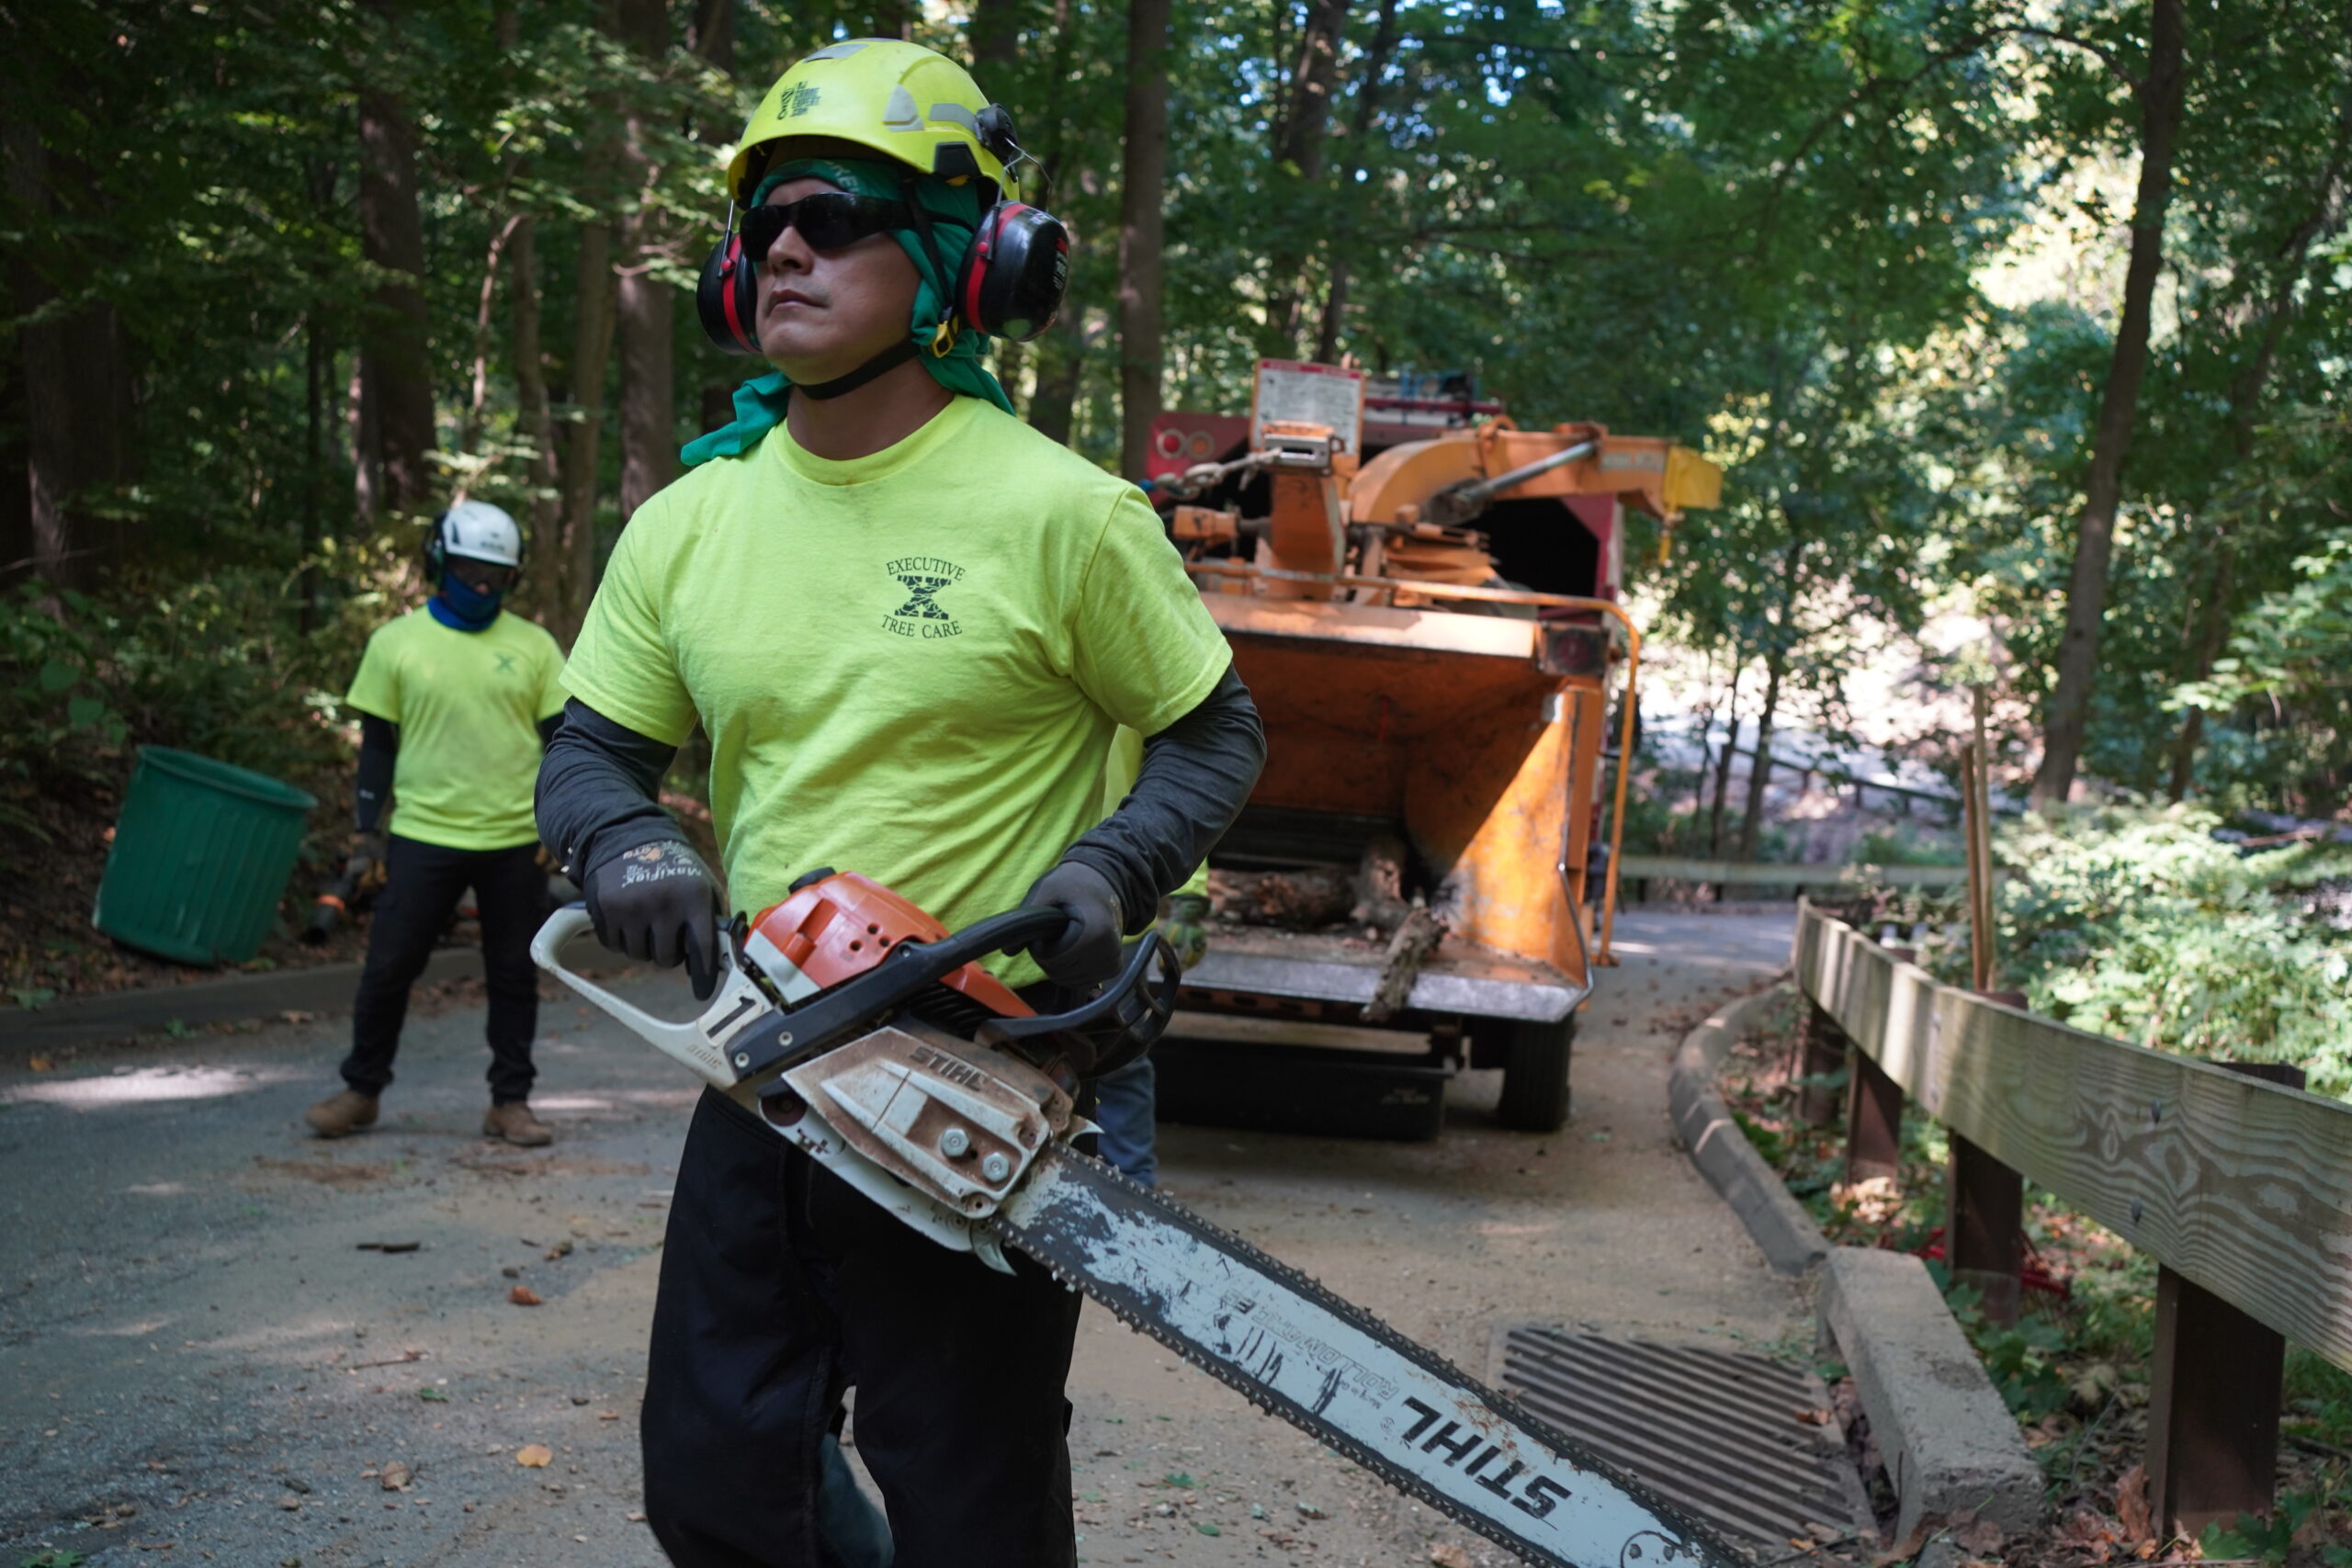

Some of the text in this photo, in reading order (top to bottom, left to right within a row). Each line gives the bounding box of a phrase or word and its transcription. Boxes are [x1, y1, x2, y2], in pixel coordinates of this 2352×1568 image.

[886, 557, 966, 581] EXECUTIVE
[881, 614, 963, 639] TREE CARE
[706, 995, 757, 1040] 1
[910, 1045, 981, 1091] STIHL
[1401, 1395, 1573, 1520] STIHL
